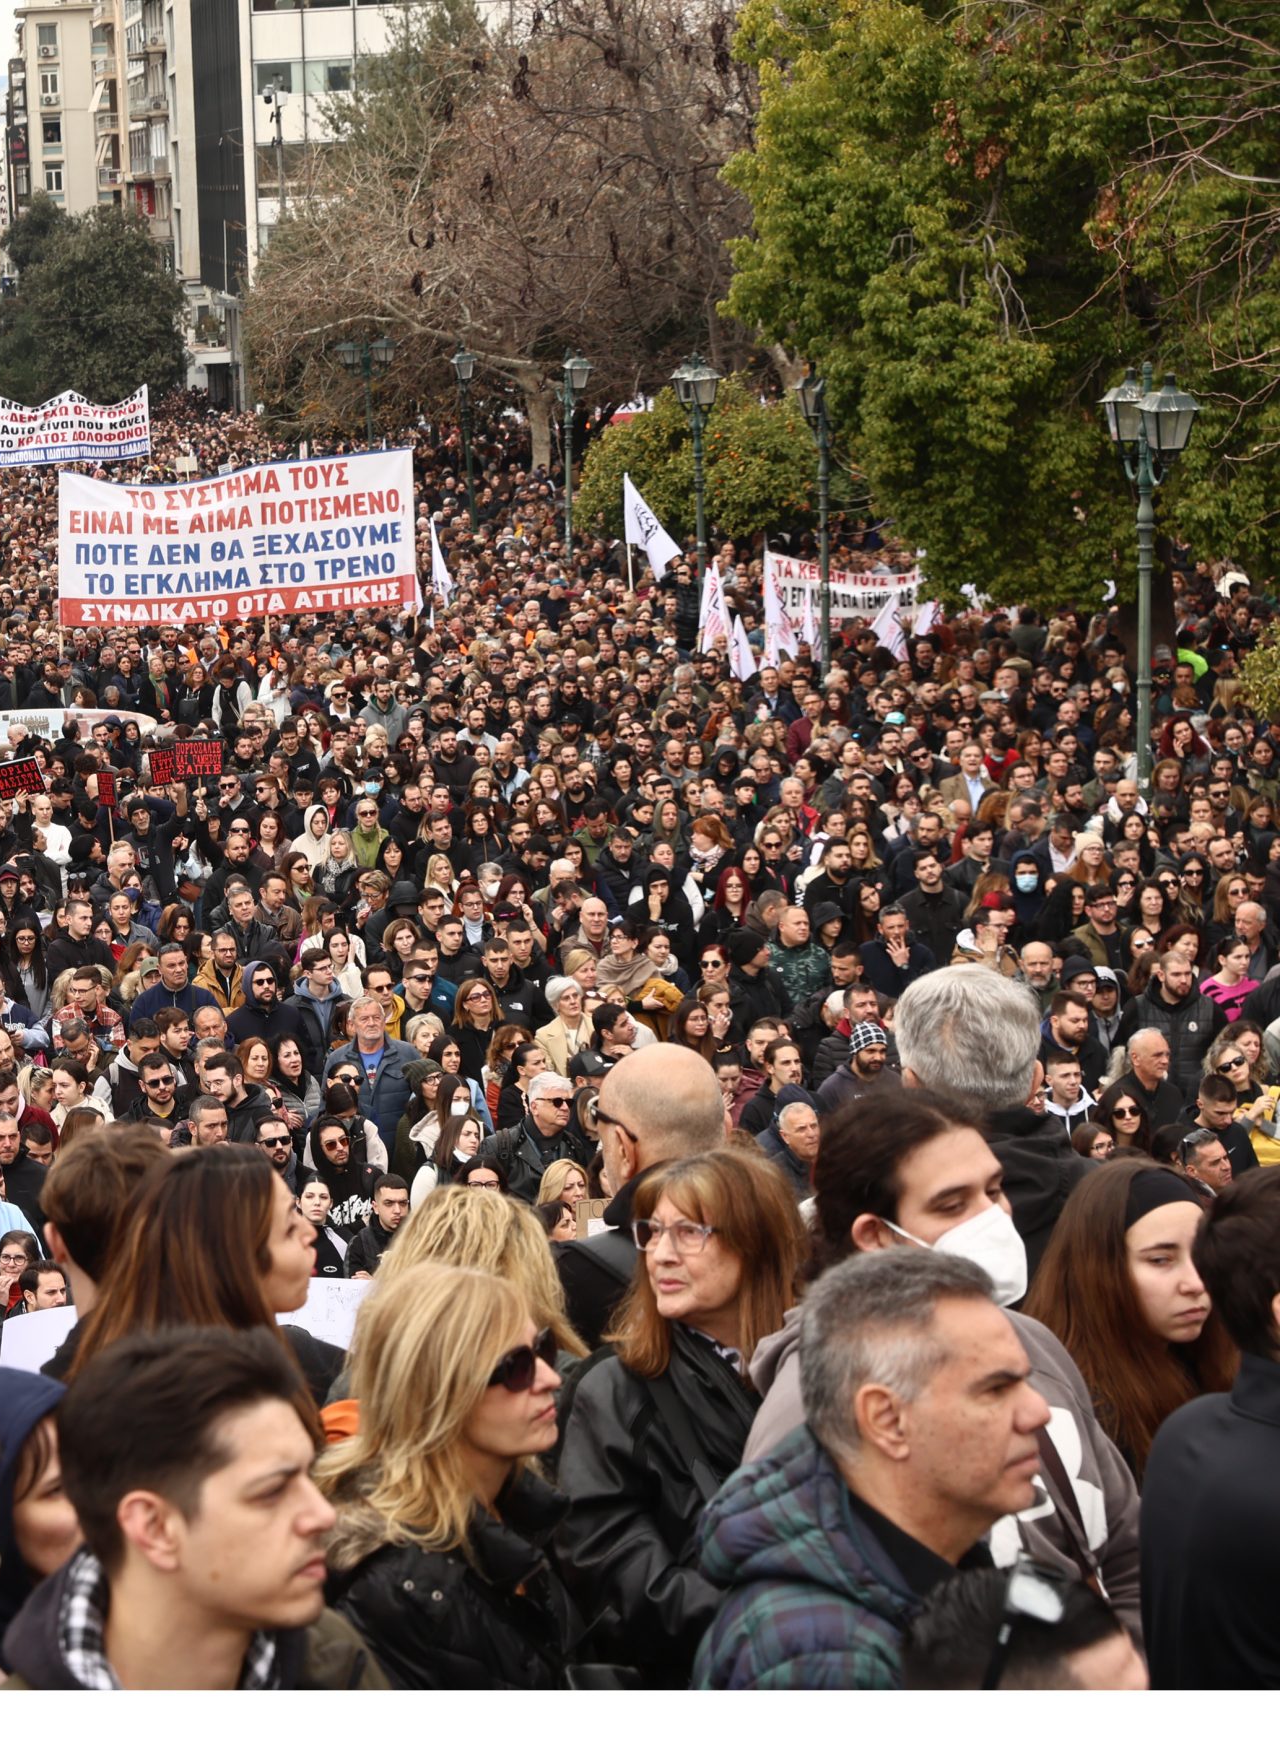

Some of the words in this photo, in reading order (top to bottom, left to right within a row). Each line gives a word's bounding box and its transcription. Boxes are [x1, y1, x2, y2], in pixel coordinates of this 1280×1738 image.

[18, 432, 68, 448] ΚΡΑΤΟΣ
[72, 426, 148, 443] ΔΟΛΟΦΟΝΟ!
[125, 490, 156, 511] ΤΟ
[164, 469, 280, 511] ΣΥΣΤΗΜΑ
[289, 462, 349, 491] ΤΟΥΣ
[69, 510, 133, 535] ΕΙΝΑΙ
[143, 513, 179, 535] ΜΕ
[188, 506, 253, 534] ΑΙΜΑ
[75, 543, 138, 566] ΠΟΤΕ
[147, 543, 200, 566] ΔΕΝ
[211, 539, 244, 562] ΘΑ
[253, 521, 402, 557] ΞΕΧΑΣΟΥΜΕ
[84, 573, 114, 595] ΤΟ
[125, 567, 251, 596] ΕΓΚΛΗΜΑ
[259, 562, 305, 585] ΣΤΟ
[314, 552, 396, 581] ΤΡΕΝΟ
[776, 560, 793, 578] ΤΑ
[799, 564, 846, 585] ΚΕΔΗ
[81, 599, 228, 622] ΣΥΝΔΙΚΑΤΟ
[237, 593, 286, 614] ΟΤΑ
[294, 581, 400, 609] ΑΤΤΙΚΗΣ
